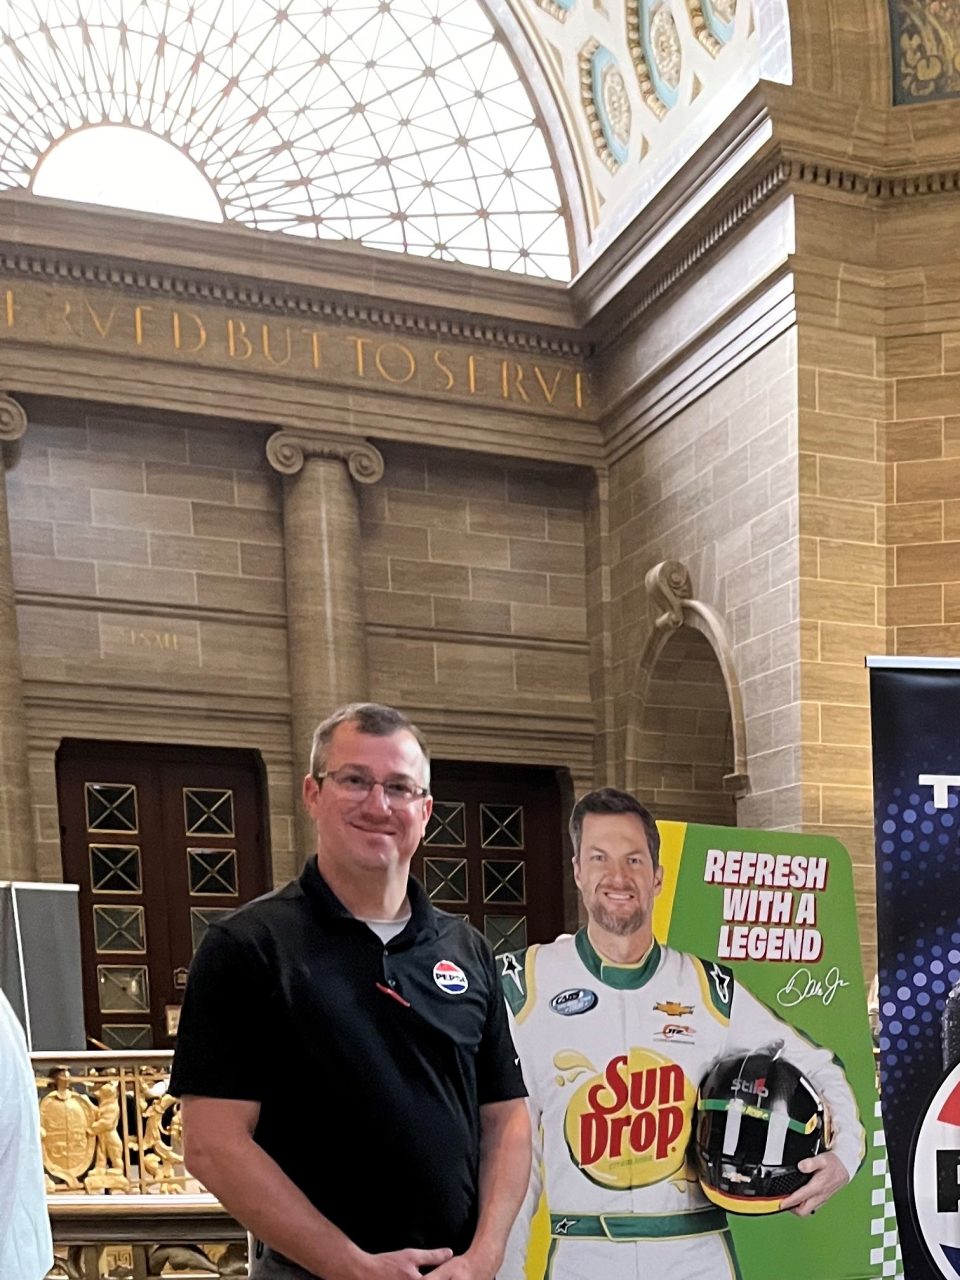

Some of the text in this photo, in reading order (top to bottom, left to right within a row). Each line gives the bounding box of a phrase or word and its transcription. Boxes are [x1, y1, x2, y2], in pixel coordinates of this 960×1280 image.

[228, 318, 329, 369] BUT
[346, 336, 415, 383] TO
[704, 849, 828, 890] REFRESH
[723, 888, 817, 925] WITH A
[717, 925, 823, 962] LEGEND
[588, 1055, 685, 1114] Sun
[579, 1107, 685, 1168] Drop
